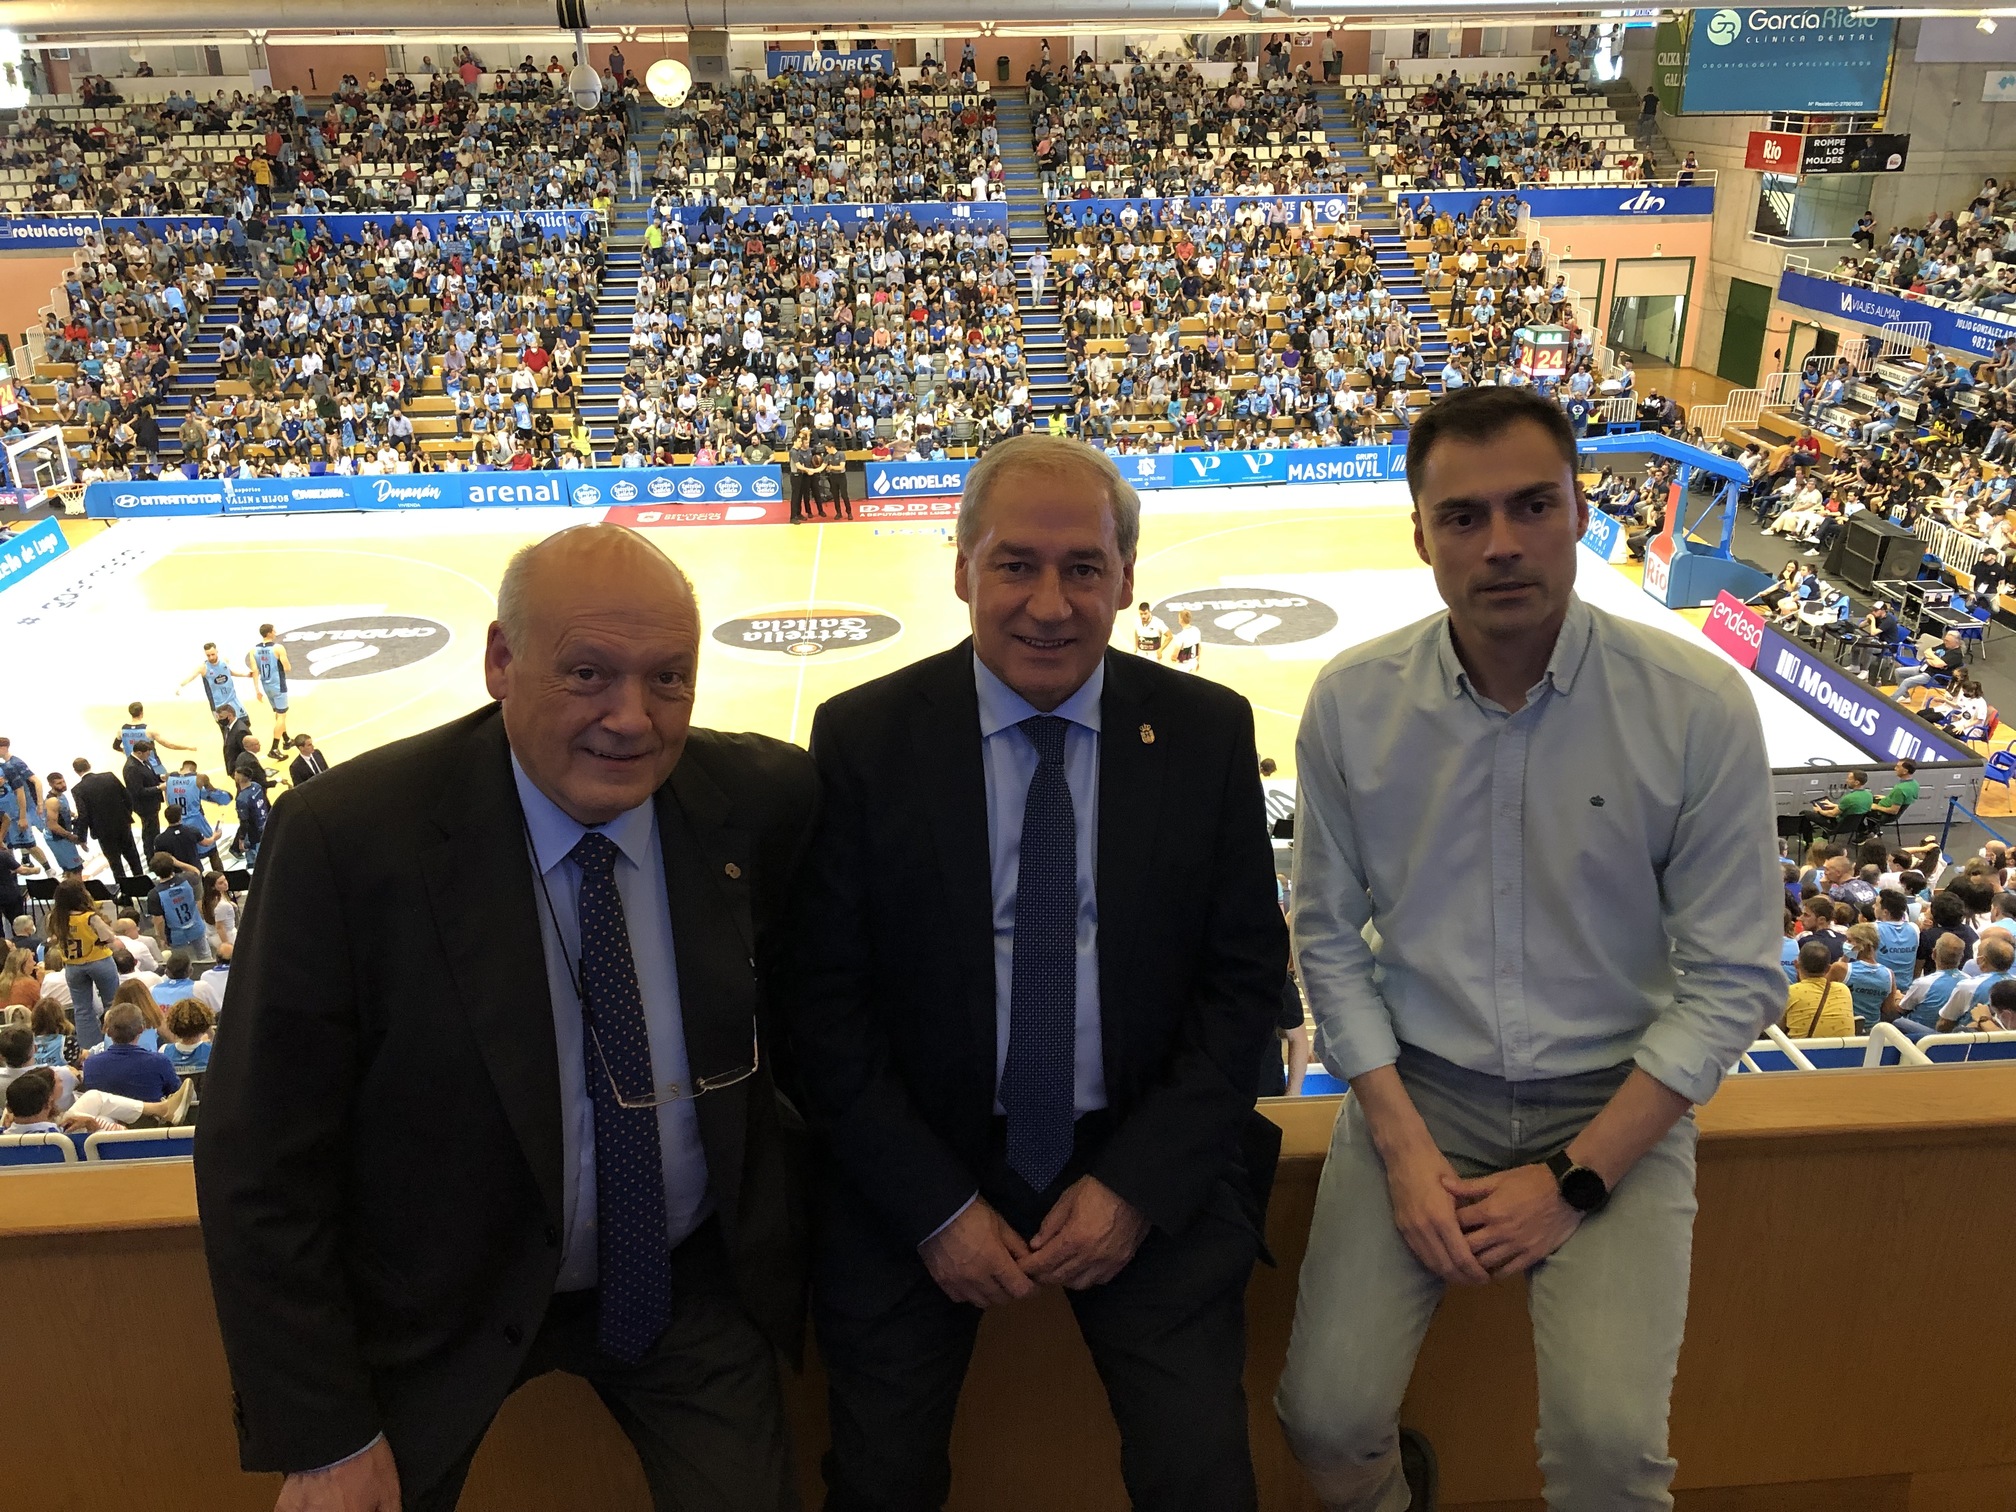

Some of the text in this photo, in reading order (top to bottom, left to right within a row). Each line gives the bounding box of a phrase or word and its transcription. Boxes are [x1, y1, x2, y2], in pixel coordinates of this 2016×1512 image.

[1748, 9, 1820, 31] García
[1746, 34, 1874, 44] CLÍNICA DENTAL
[1762, 139, 1782, 161] Río
[1813, 138, 1847, 147] ROMPE
[1826, 147, 1845, 155] LOS
[1805, 156, 1843, 165] MOLDES
[1852, 301, 1875, 315] VIAJES
[1875, 306, 1901, 321] ALMAR
[1972, 335, 1986, 349] 982
[1522, 346, 1533, 367] 24
[1537, 350, 1563, 369] 24
[892, 474, 961, 490] CANDELAS
[469, 480, 561, 503] arenal
[1165, 598, 1309, 612] CANDELAS
[1713, 601, 1763, 649] endesa
[282, 627, 437, 643] CANDELAS
[174, 903, 193, 925] 13
